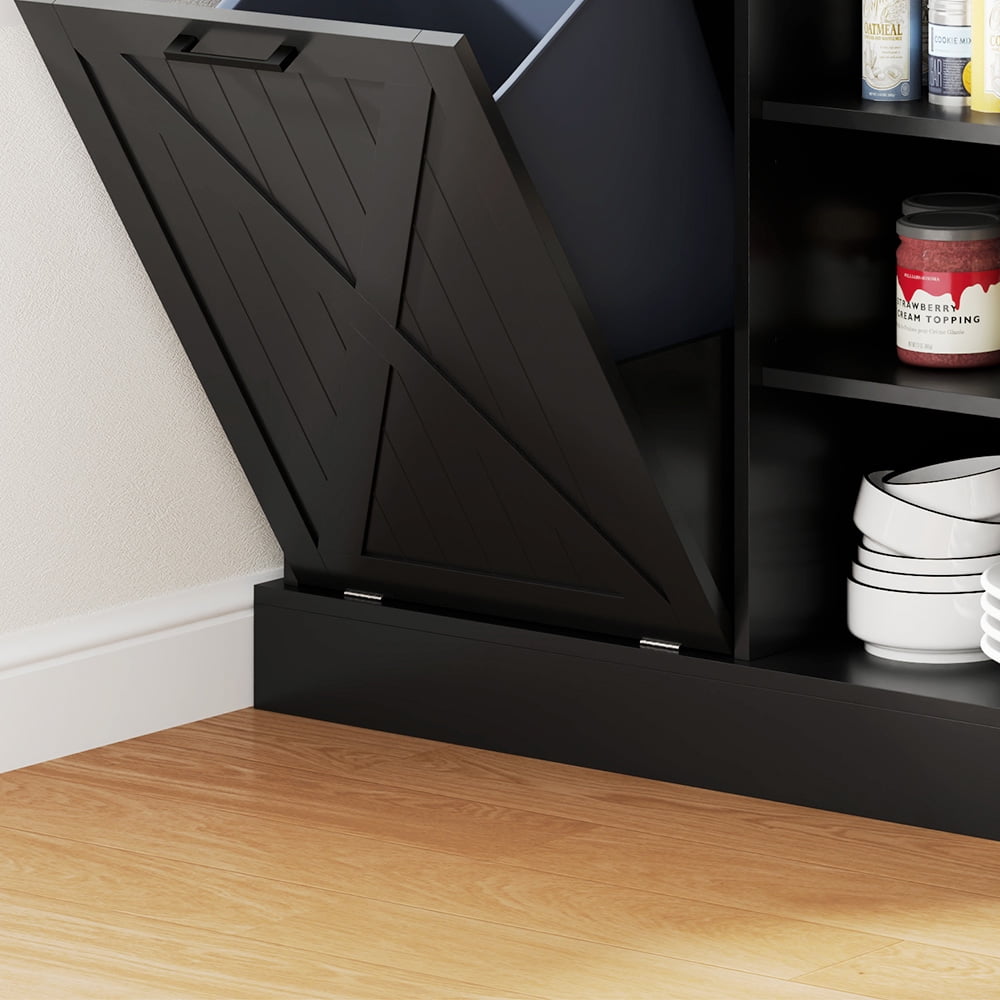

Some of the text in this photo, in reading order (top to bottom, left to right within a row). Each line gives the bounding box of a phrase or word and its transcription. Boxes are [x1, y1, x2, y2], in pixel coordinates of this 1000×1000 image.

[864, 22, 903, 36] OATMEAL
[935, 35, 958, 44] COOKIE
[897, 297, 957, 312] STRAWBERRY
[898, 309, 981, 324] CREAM TOPPING
